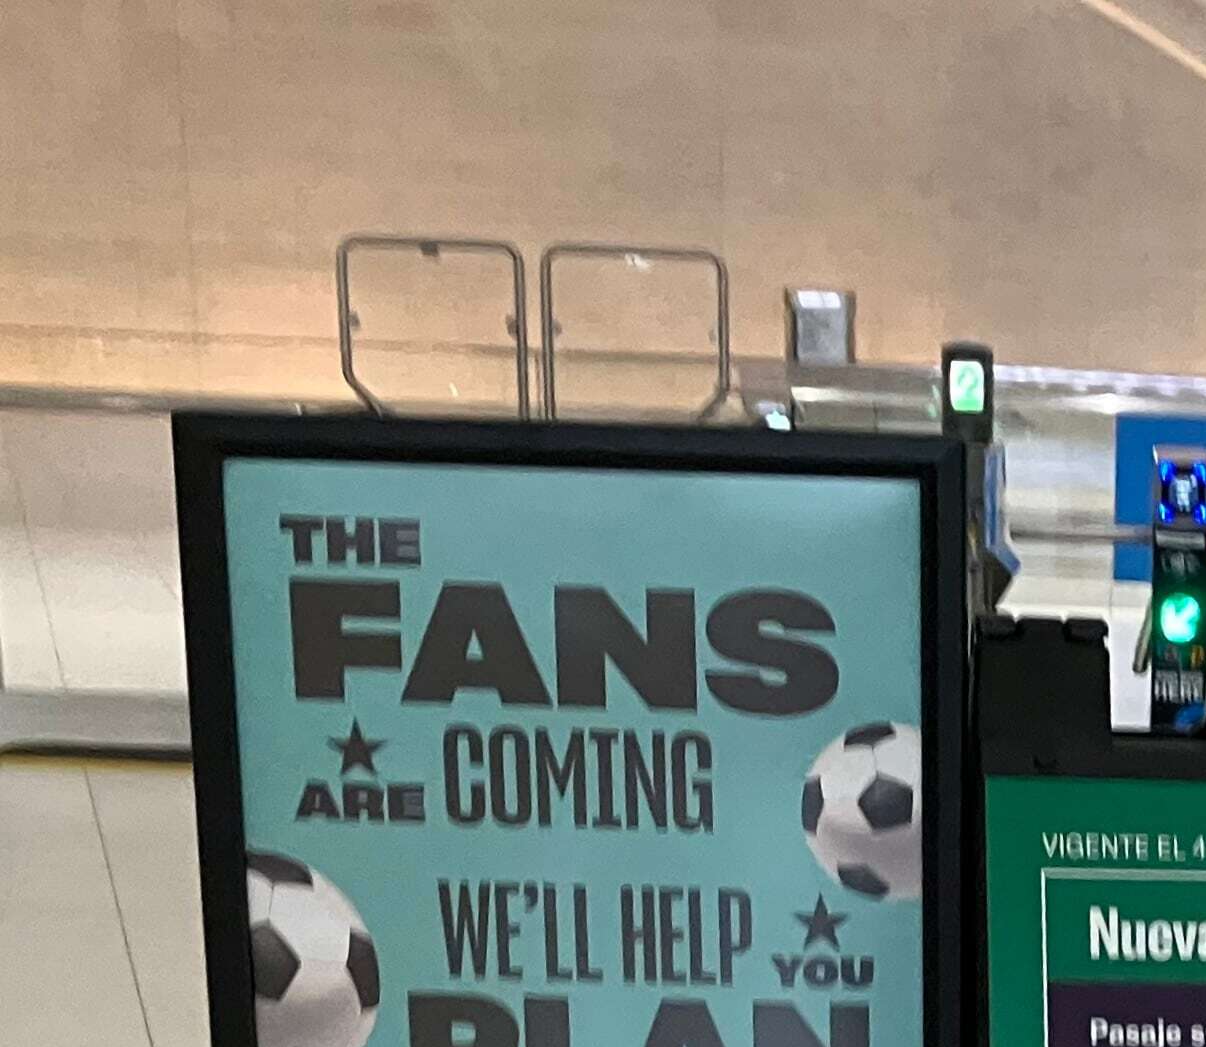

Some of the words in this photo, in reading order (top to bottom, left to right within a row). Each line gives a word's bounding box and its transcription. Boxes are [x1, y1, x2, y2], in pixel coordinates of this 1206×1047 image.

[279, 512, 421, 568] THE
[289, 574, 840, 718] FANS
[296, 778, 425, 825] ARE
[443, 720, 714, 833] COMING
[1042, 831, 1149, 861] VIGENTE
[1157, 833, 1186, 862] EL
[1192, 834, 1205, 861] 4
[437, 877, 603, 984] WE'LL
[620, 883, 752, 987] HELP
[772, 954, 875, 990] YOU
